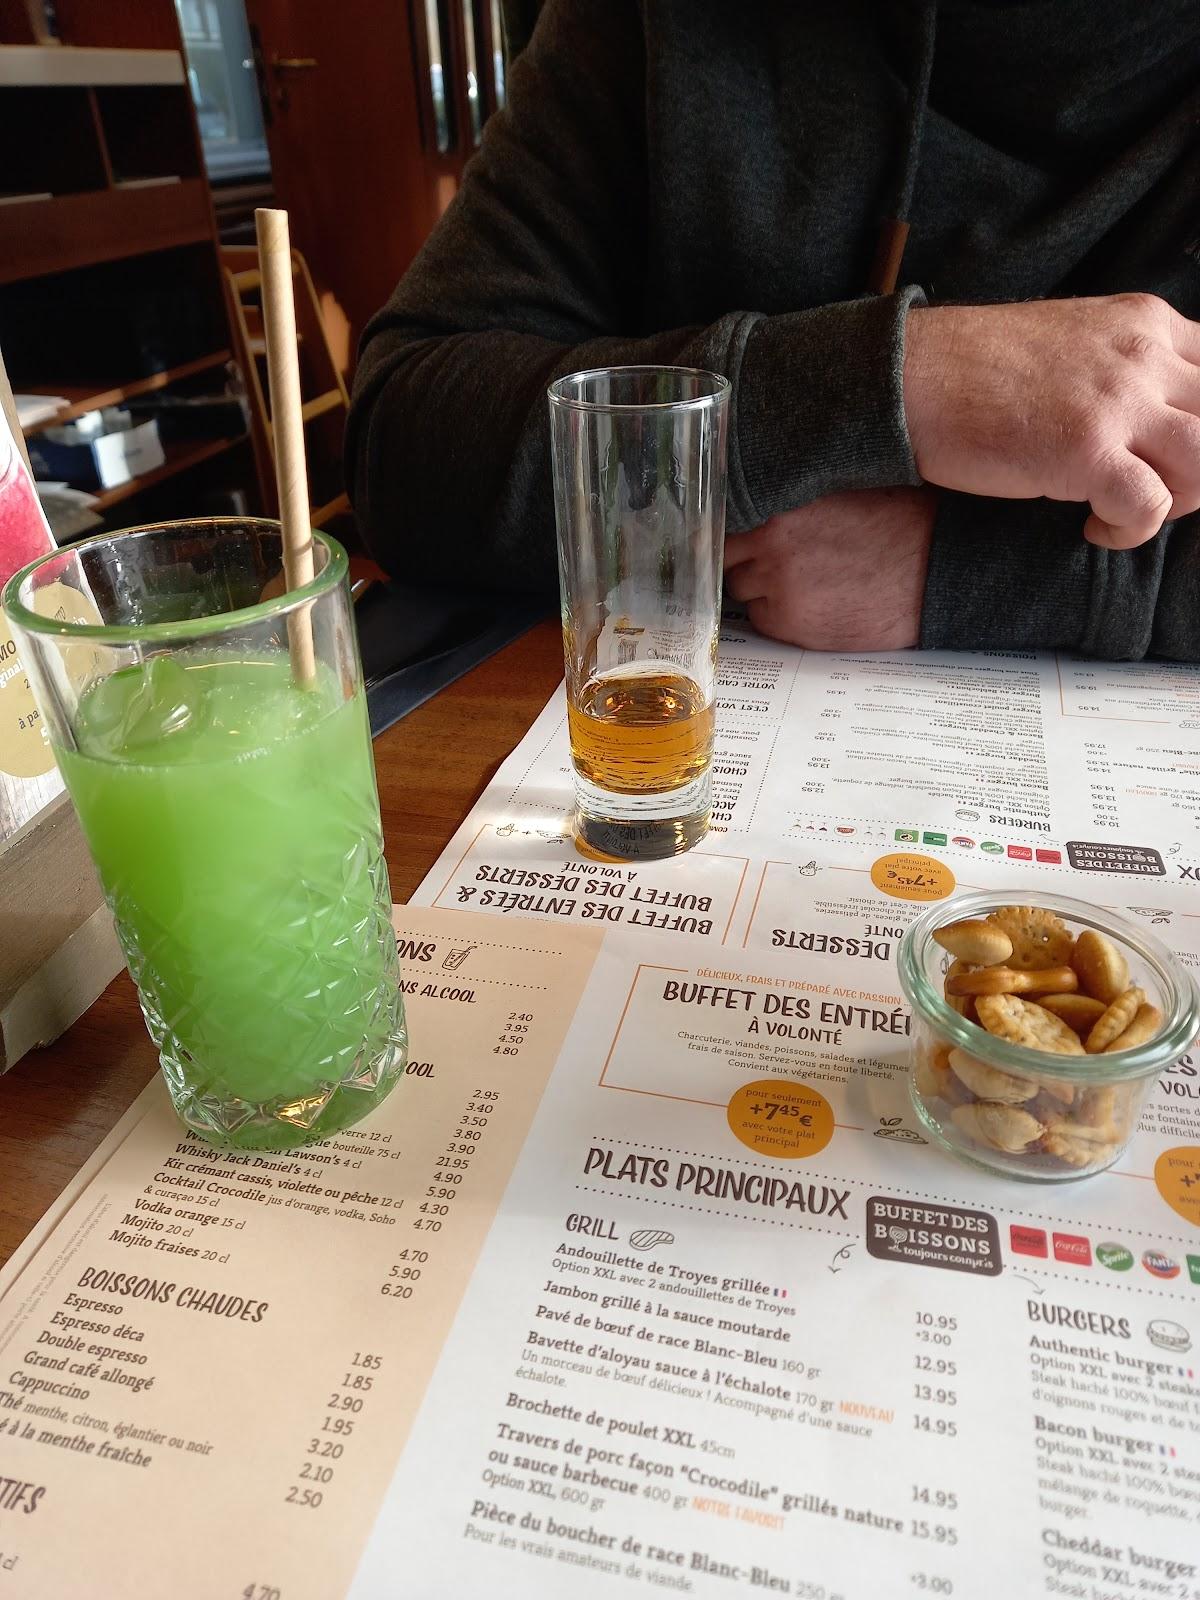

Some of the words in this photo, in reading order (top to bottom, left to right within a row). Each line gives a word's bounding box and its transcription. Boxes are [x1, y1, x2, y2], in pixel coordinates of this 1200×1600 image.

[968, 802, 1001, 810] burger
[1003, 807, 1051, 818] Authentic
[1092, 803, 1118, 811] 12.95
[989, 815, 1051, 833] BURGERS
[1093, 820, 1120, 828] 10.95
[560, 861, 622, 880] VOLONTÉ
[1076, 860, 1102, 868] DES
[1105, 861, 1160, 873] BUFFET
[476, 864, 580, 892] DESSERTS
[627, 872, 638, 883] À
[879, 883, 921, 893] seulement
[456, 886, 477, 903] &
[584, 879, 626, 899] DES
[479, 889, 577, 918] ENTRÉES
[629, 887, 713, 913] BUFFET
[581, 902, 625, 922] DES
[627, 908, 713, 936] BUFFET
[772, 929, 891, 961] DESSERTS
[420, 985, 477, 1003] ALCOOL
[696, 967, 743, 983] DÉLICIEUX,
[745, 974, 774, 986] FRAIS
[775, 977, 788, 988] ET
[788, 979, 832, 994] PRÉPARÉ
[833, 987, 858, 998] AVEC
[858, 991, 902, 1005] PASSION
[662, 980, 756, 1012] BUFFET
[762, 993, 811, 1019] DES
[508, 1012, 534, 1022] 2.40
[504, 1023, 529, 1033] 3.95
[748, 1016, 760, 1034] À
[766, 1021, 843, 1046] VOLONTÉ
[498, 1034, 524, 1045] 4.50
[492, 1046, 519, 1056] 4.80
[677, 1030, 732, 1048] Charcuterie,
[735, 1039, 773, 1052] viandes,
[774, 1045, 818, 1060] poissons,
[820, 1050, 855, 1063] salades
[857, 1056, 867, 1065] et
[869, 1057, 910, 1074] légumes
[688, 1042, 709, 1053] frais
[711, 1046, 722, 1055] de
[724, 1048, 756, 1060] saison.
[758, 1051, 817, 1068] Servez-vous
[819, 1062, 831, 1070] en
[832, 1062, 858, 1074] toute
[860, 1065, 896, 1081] liberté.
[728, 1059, 769, 1074] Convient
[771, 1066, 788, 1075] aux
[790, 1066, 850, 1084] végétariens.
[745, 1088, 769, 1100] pour
[772, 1093, 822, 1107] seulement
[459, 1115, 488, 1127] 3.50
[742, 1121, 763, 1132] avec
[766, 1124, 793, 1136] votre
[795, 1127, 816, 1139] plat
[453, 1128, 482, 1141] 3.80
[754, 1133, 800, 1149] principal
[175, 1143, 223, 1161] Whisky
[223, 1153, 250, 1168] Jack
[252, 1158, 302, 1175] Daniel's
[332, 1141, 375, 1156] bouteille
[376, 1149, 389, 1159] 75
[390, 1151, 401, 1160] cl
[446, 1142, 476, 1155] 3.90
[435, 1156, 470, 1170] 21.95
[164, 1157, 185, 1171] Kir
[185, 1161, 237, 1180] crémant
[237, 1171, 274, 1188] cassis,
[277, 1178, 323, 1196] violette
[324, 1188, 341, 1199] ou
[342, 1188, 379, 1205] pêche
[381, 1197, 393, 1207] 12
[394, 1199, 404, 1209] cl
[433, 1171, 463, 1185] 4.90
[583, 1147, 669, 1188] PLATS
[675, 1162, 851, 1221] PRINCIPAUX
[144, 1185, 154, 1194] &
[155, 1188, 194, 1204] curaçao
[196, 1195, 208, 1205] 15
[209, 1197, 221, 1208] cl
[153, 1171, 207, 1191] Cocktail
[206, 1182, 267, 1202] Crocodile
[265, 1194, 282, 1206] jus
[285, 1197, 330, 1216] d'orange,
[334, 1207, 367, 1222] vodka,
[369, 1212, 396, 1225] Soho
[425, 1186, 456, 1200] 5.90
[134, 1198, 173, 1216] Vodka
[174, 1208, 220, 1227] orange
[220, 1217, 234, 1228] 15
[235, 1220, 247, 1231] cl
[419, 1201, 449, 1216] 4.30
[873, 1202, 952, 1228] BUFFET
[955, 1215, 988, 1233] DES
[120, 1213, 164, 1234] Mojito
[165, 1223, 181, 1236] 20
[182, 1227, 194, 1239] cl
[413, 1218, 442, 1232] 4.70
[566, 1213, 620, 1241] GRILL
[108, 1229, 153, 1250] Mojito
[153, 1237, 200, 1257] fraises
[201, 1249, 218, 1262] 20
[218, 1253, 231, 1265] cl
[399, 1248, 429, 1263] 4.70
[903, 1245, 947, 1262] toujours
[948, 1252, 994, 1269] compris
[388, 1264, 421, 1281] 5.90
[556, 1243, 645, 1270] Andouillette
[647, 1261, 664, 1275] de
[668, 1265, 718, 1287] Troyes
[721, 1277, 770, 1295] grillée
[77, 1266, 177, 1304] BOISSONS
[176, 1285, 270, 1323] CHAUDES
[380, 1283, 413, 1300] 6.20
[63, 1292, 124, 1315] Espresso
[543, 1280, 599, 1302] Jambon
[601, 1294, 641, 1313] grillé
[644, 1301, 653, 1315] à
[657, 1304, 670, 1319] la
[673, 1310, 714, 1327] sauce
[717, 1319, 791, 1342] moutarde
[50, 1311, 111, 1335] Espresso
[113, 1324, 145, 1342] déca
[916, 1311, 958, 1332] 10.95
[1027, 1299, 1132, 1341] BURGERS
[36, 1330, 86, 1352] Double
[87, 1343, 148, 1366] espresso
[1029, 1335, 1110, 1363] Authentic
[1115, 1351, 1173, 1376] burger
[23, 1350, 70, 1372] Grand
[68, 1361, 102, 1380] café
[100, 1367, 155, 1393] allongé
[351, 1352, 382, 1371] 1.85
[915, 1355, 958, 1376] 12.95
[9, 1370, 90, 1401] Cappuccino
[913, 1415, 958, 1438] 14.95
[1035, 1415, 1088, 1440] Bacon
[1093, 1427, 1155, 1453] burger
